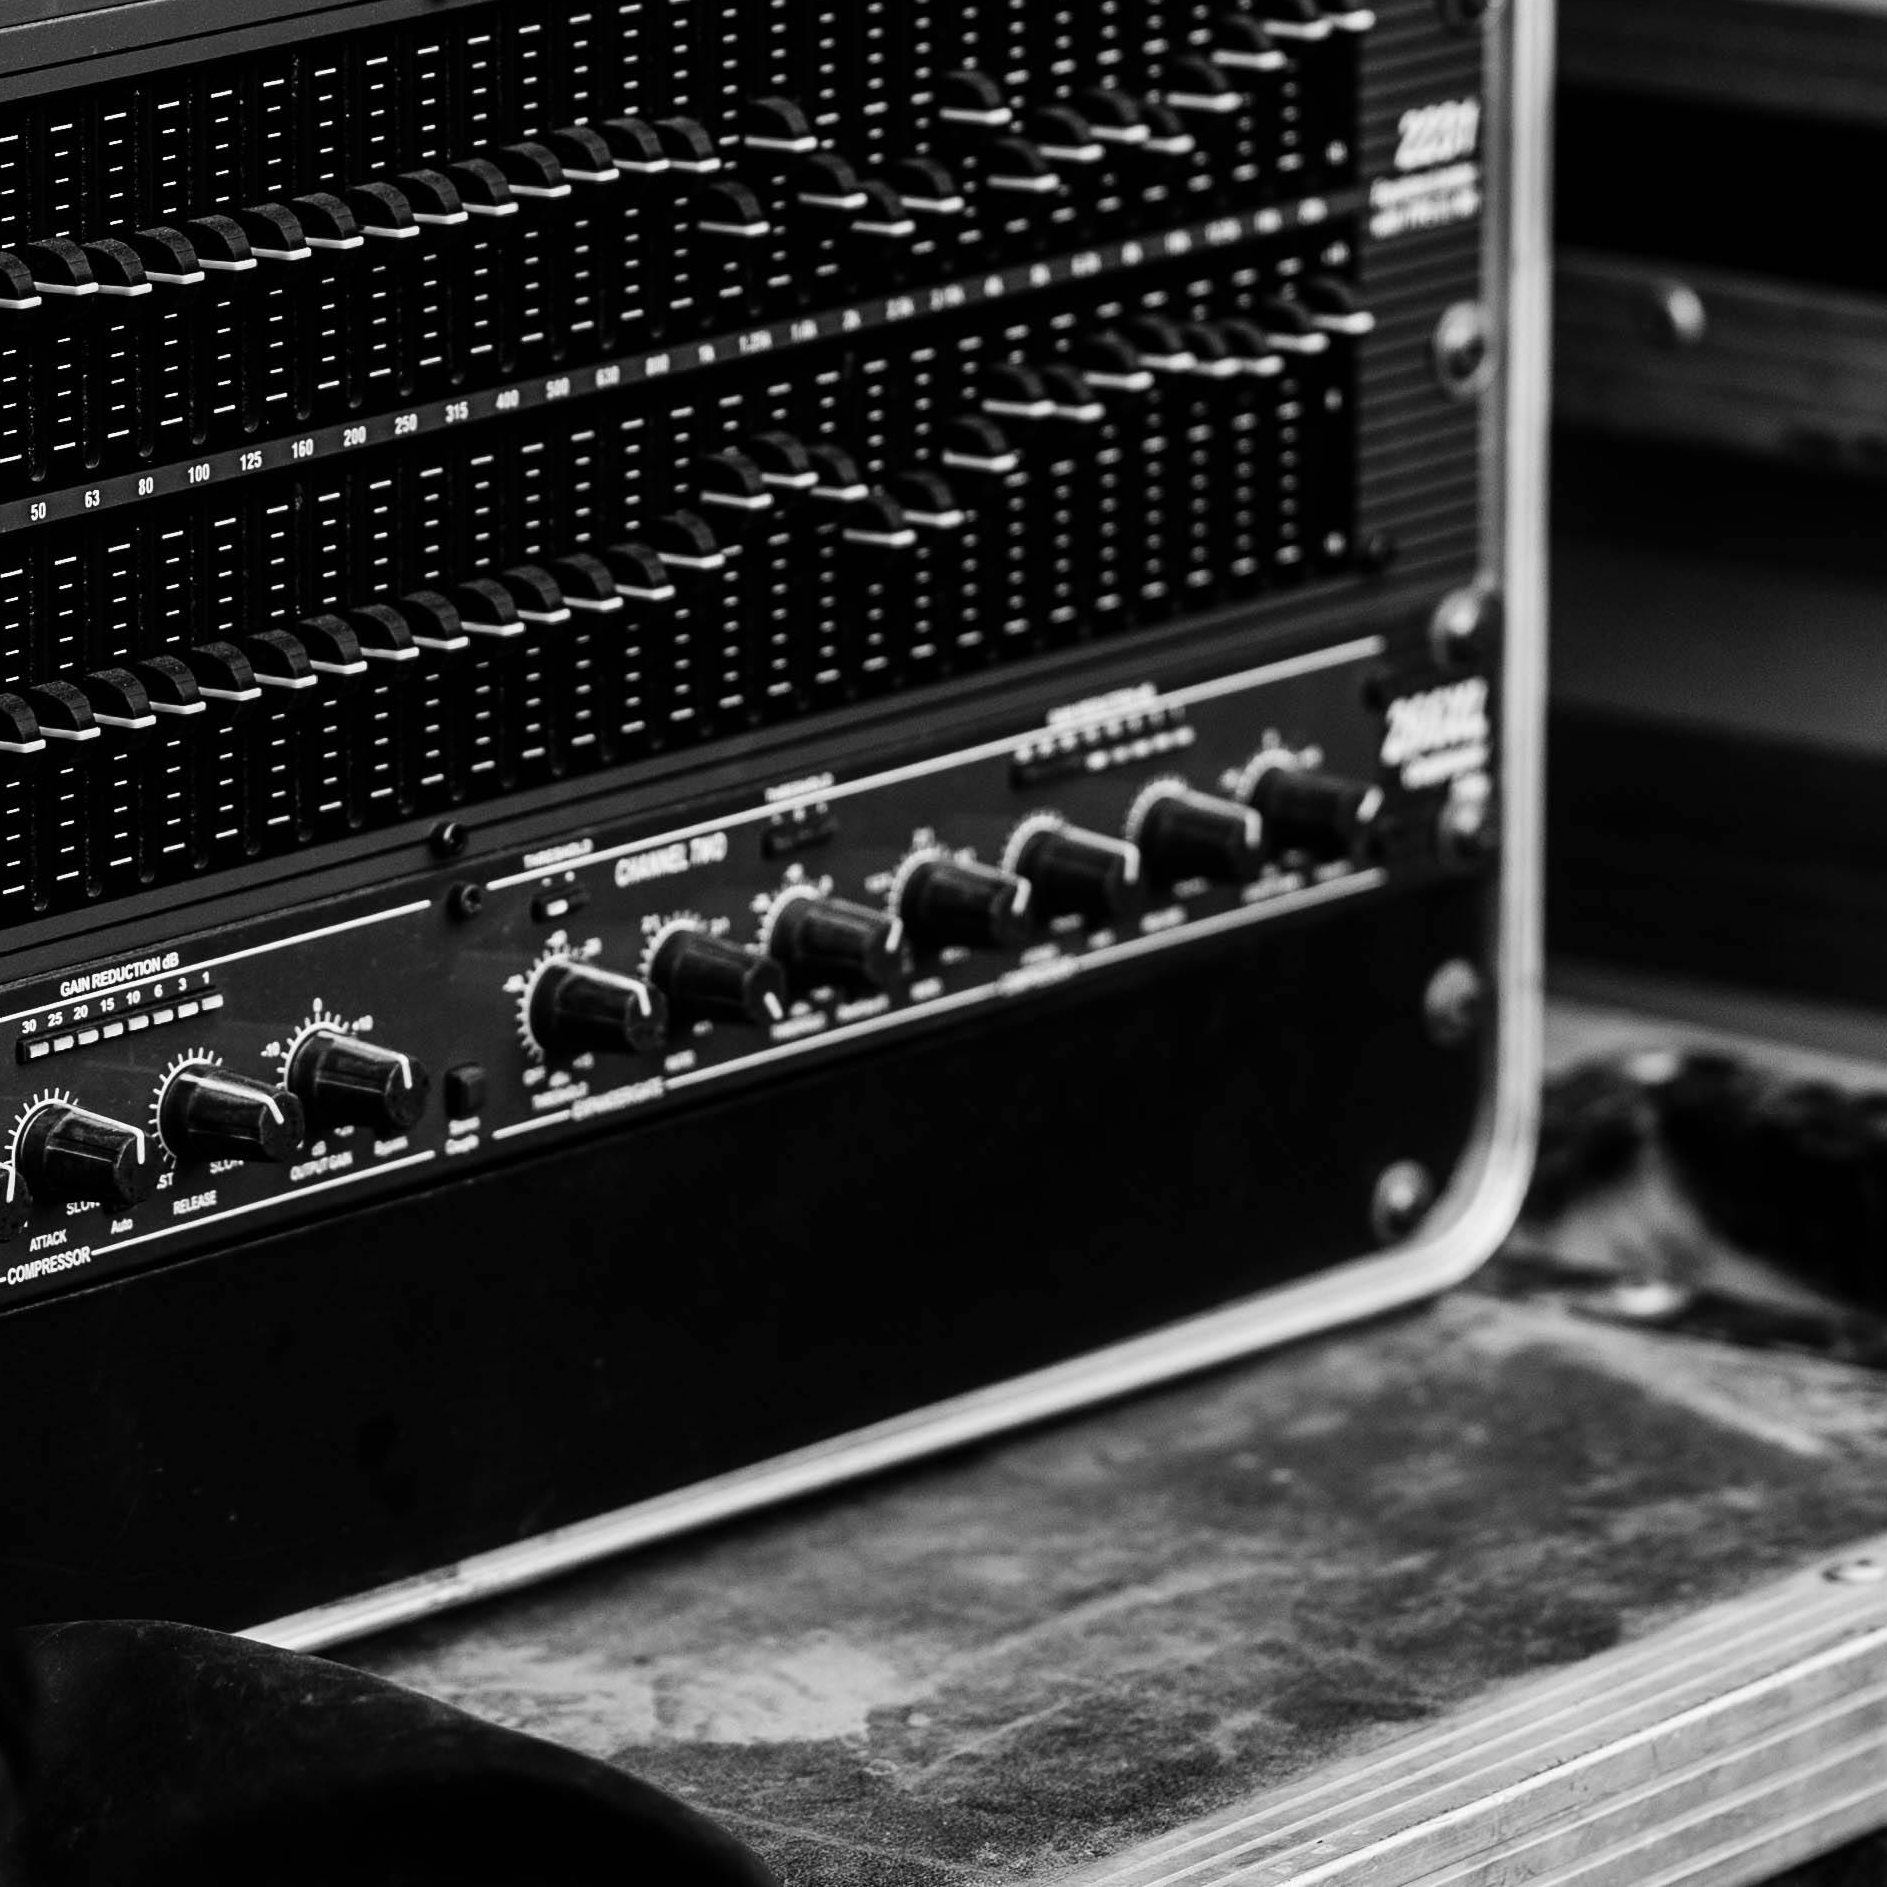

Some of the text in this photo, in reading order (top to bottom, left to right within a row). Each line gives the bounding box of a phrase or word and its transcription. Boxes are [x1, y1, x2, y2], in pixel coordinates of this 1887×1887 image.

[31, 502, 46, 521] 50
[85, 490, 100, 508] 63
[139, 477, 153, 495] 80
[188, 464, 210, 483] 100
[240, 451, 262, 471] 125
[292, 439, 313, 458] 160
[344, 426, 366, 447] 200
[395, 414, 417, 434] 250
[446, 401, 468, 423] 315
[60, 952, 179, 997] GAIN REDUCTION dB
[22, 971, 209, 1033] 30 25 20 15 10 6 3 1
[173, 1190, 217, 1215] RELEASE
[30, 1229, 67, 1252] ATTACK
[111, 1219, 133, 1234] Auto
[7, 1246, 91, 1285] COMPRESSOR
